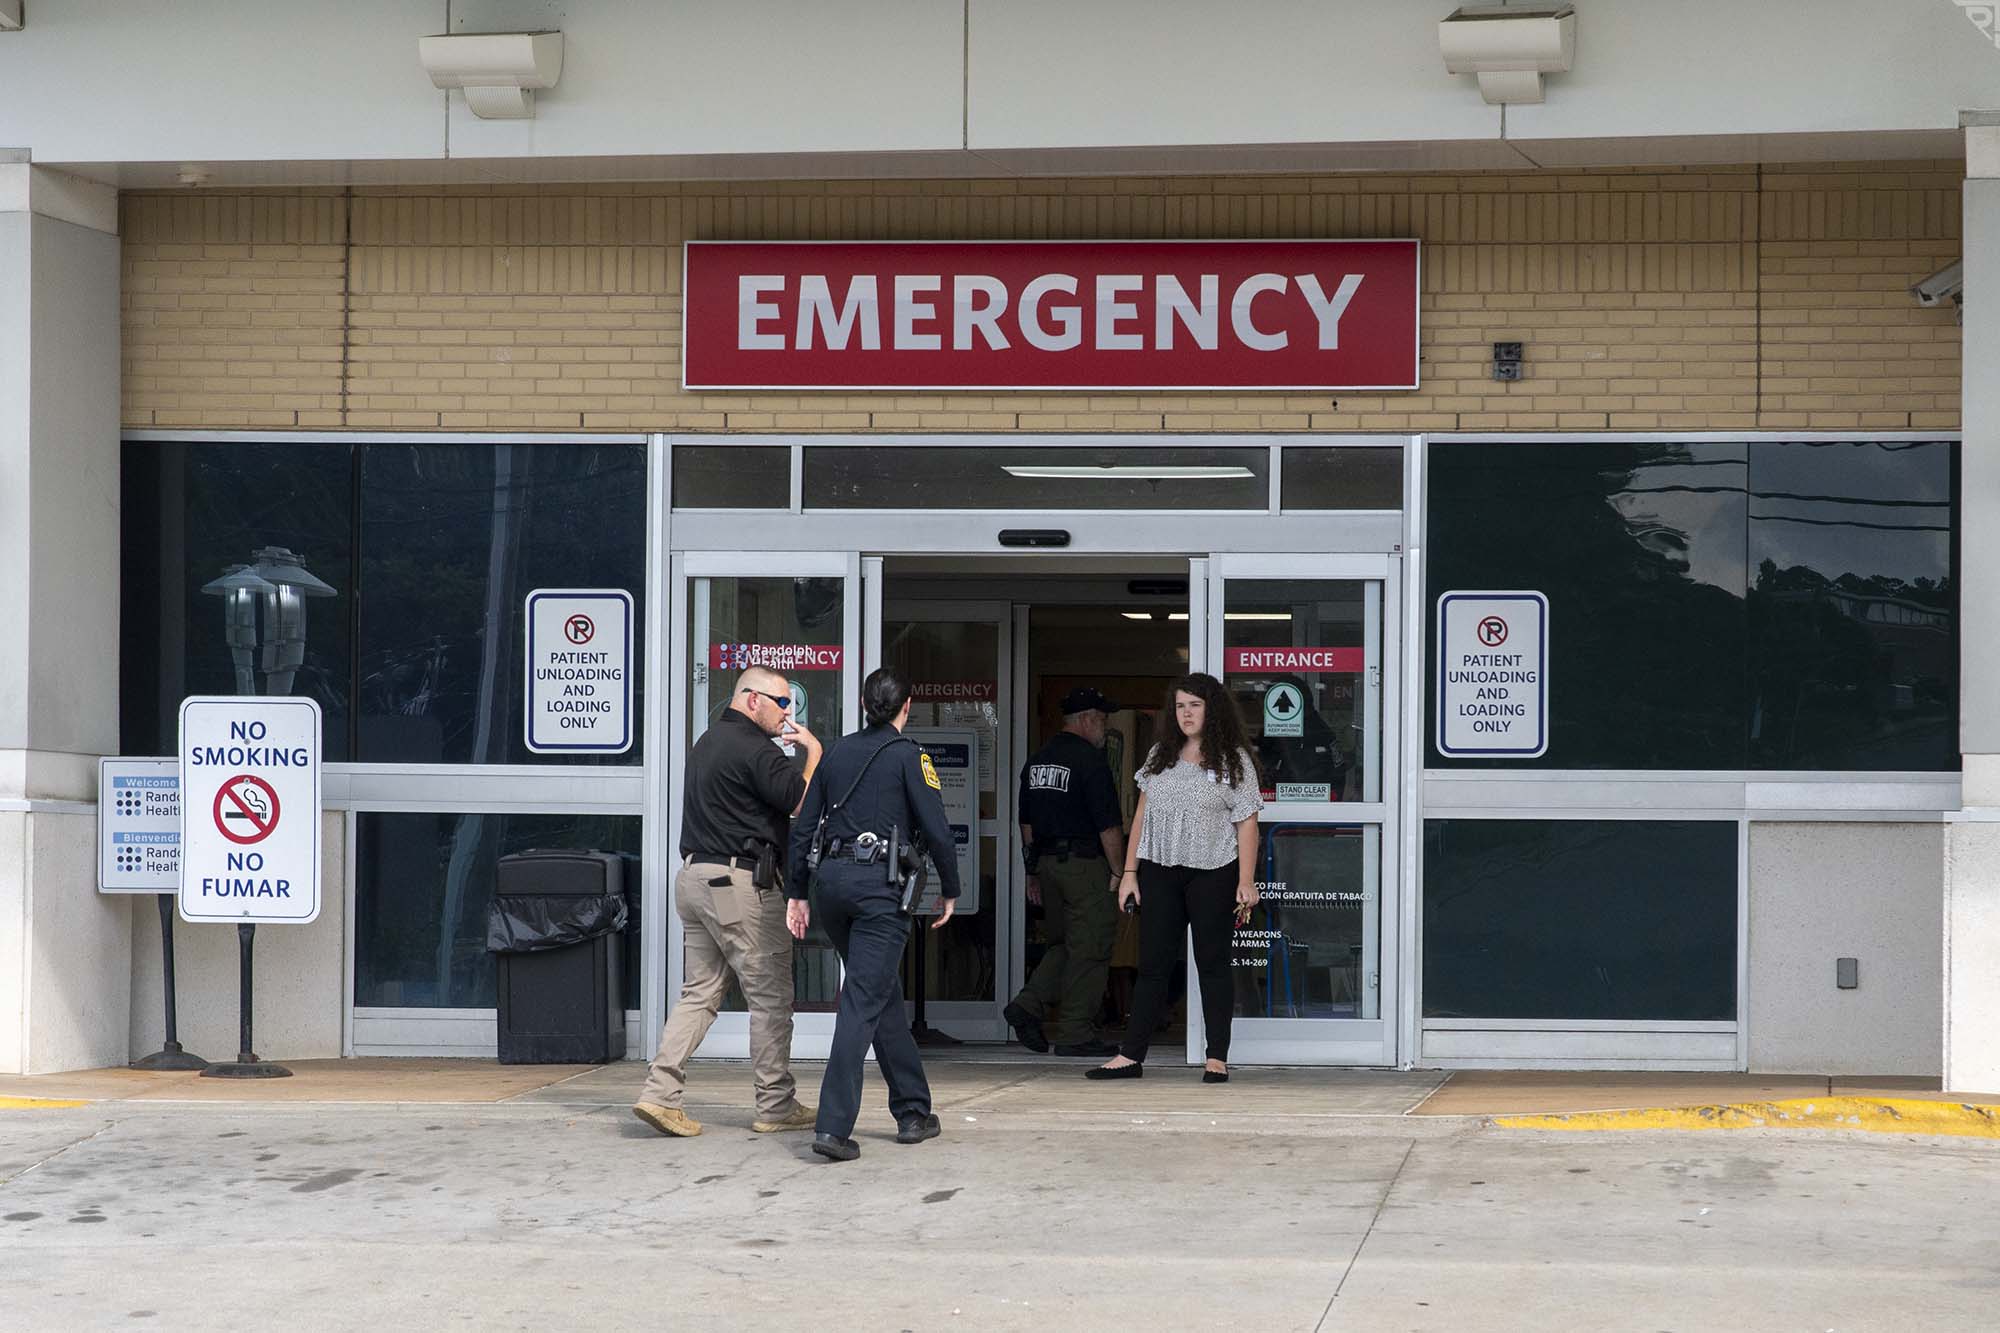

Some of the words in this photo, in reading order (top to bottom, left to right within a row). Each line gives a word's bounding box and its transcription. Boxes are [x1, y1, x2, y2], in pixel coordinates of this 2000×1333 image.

[738, 273, 1366, 352] EMERGENCY
[550, 652, 608, 664] PATIENT
[751, 644, 813, 659] Randolph
[1239, 652, 1334, 668] ENTRANCE
[1463, 654, 1523, 667] PATIENT
[536, 668, 622, 681] UNLOADING
[1449, 671, 1537, 683] UNLOADING
[563, 684, 595, 696] AND
[911, 683, 992, 696] MERGENCY
[1476, 687, 1509, 700] AND
[547, 700, 611, 713] LOADING
[1459, 703, 1525, 716] LOADING
[560, 716, 598, 729] ONLY
[1472, 720, 1512, 733] ONLY
[230, 720, 267, 740] NO
[191, 746, 309, 767] SMOKING
[126, 778, 177, 788] Welcome
[1279, 786, 1303, 794] STAND
[1304, 786, 1327, 794] CLEAR
[147, 861, 178, 872] Healt
[227, 852, 264, 872] NO
[202, 878, 292, 898] FUMAR
[1267, 882, 1287, 890] FREE
[1259, 890, 1281, 900] CIÓN
[1282, 892, 1324, 900] GRATUITA
[1326, 892, 1337, 900] DE
[1240, 930, 1282, 939] WEAPONS
[1240, 940, 1271, 948] ARMAS
[1241, 958, 1268, 967] 14-269
